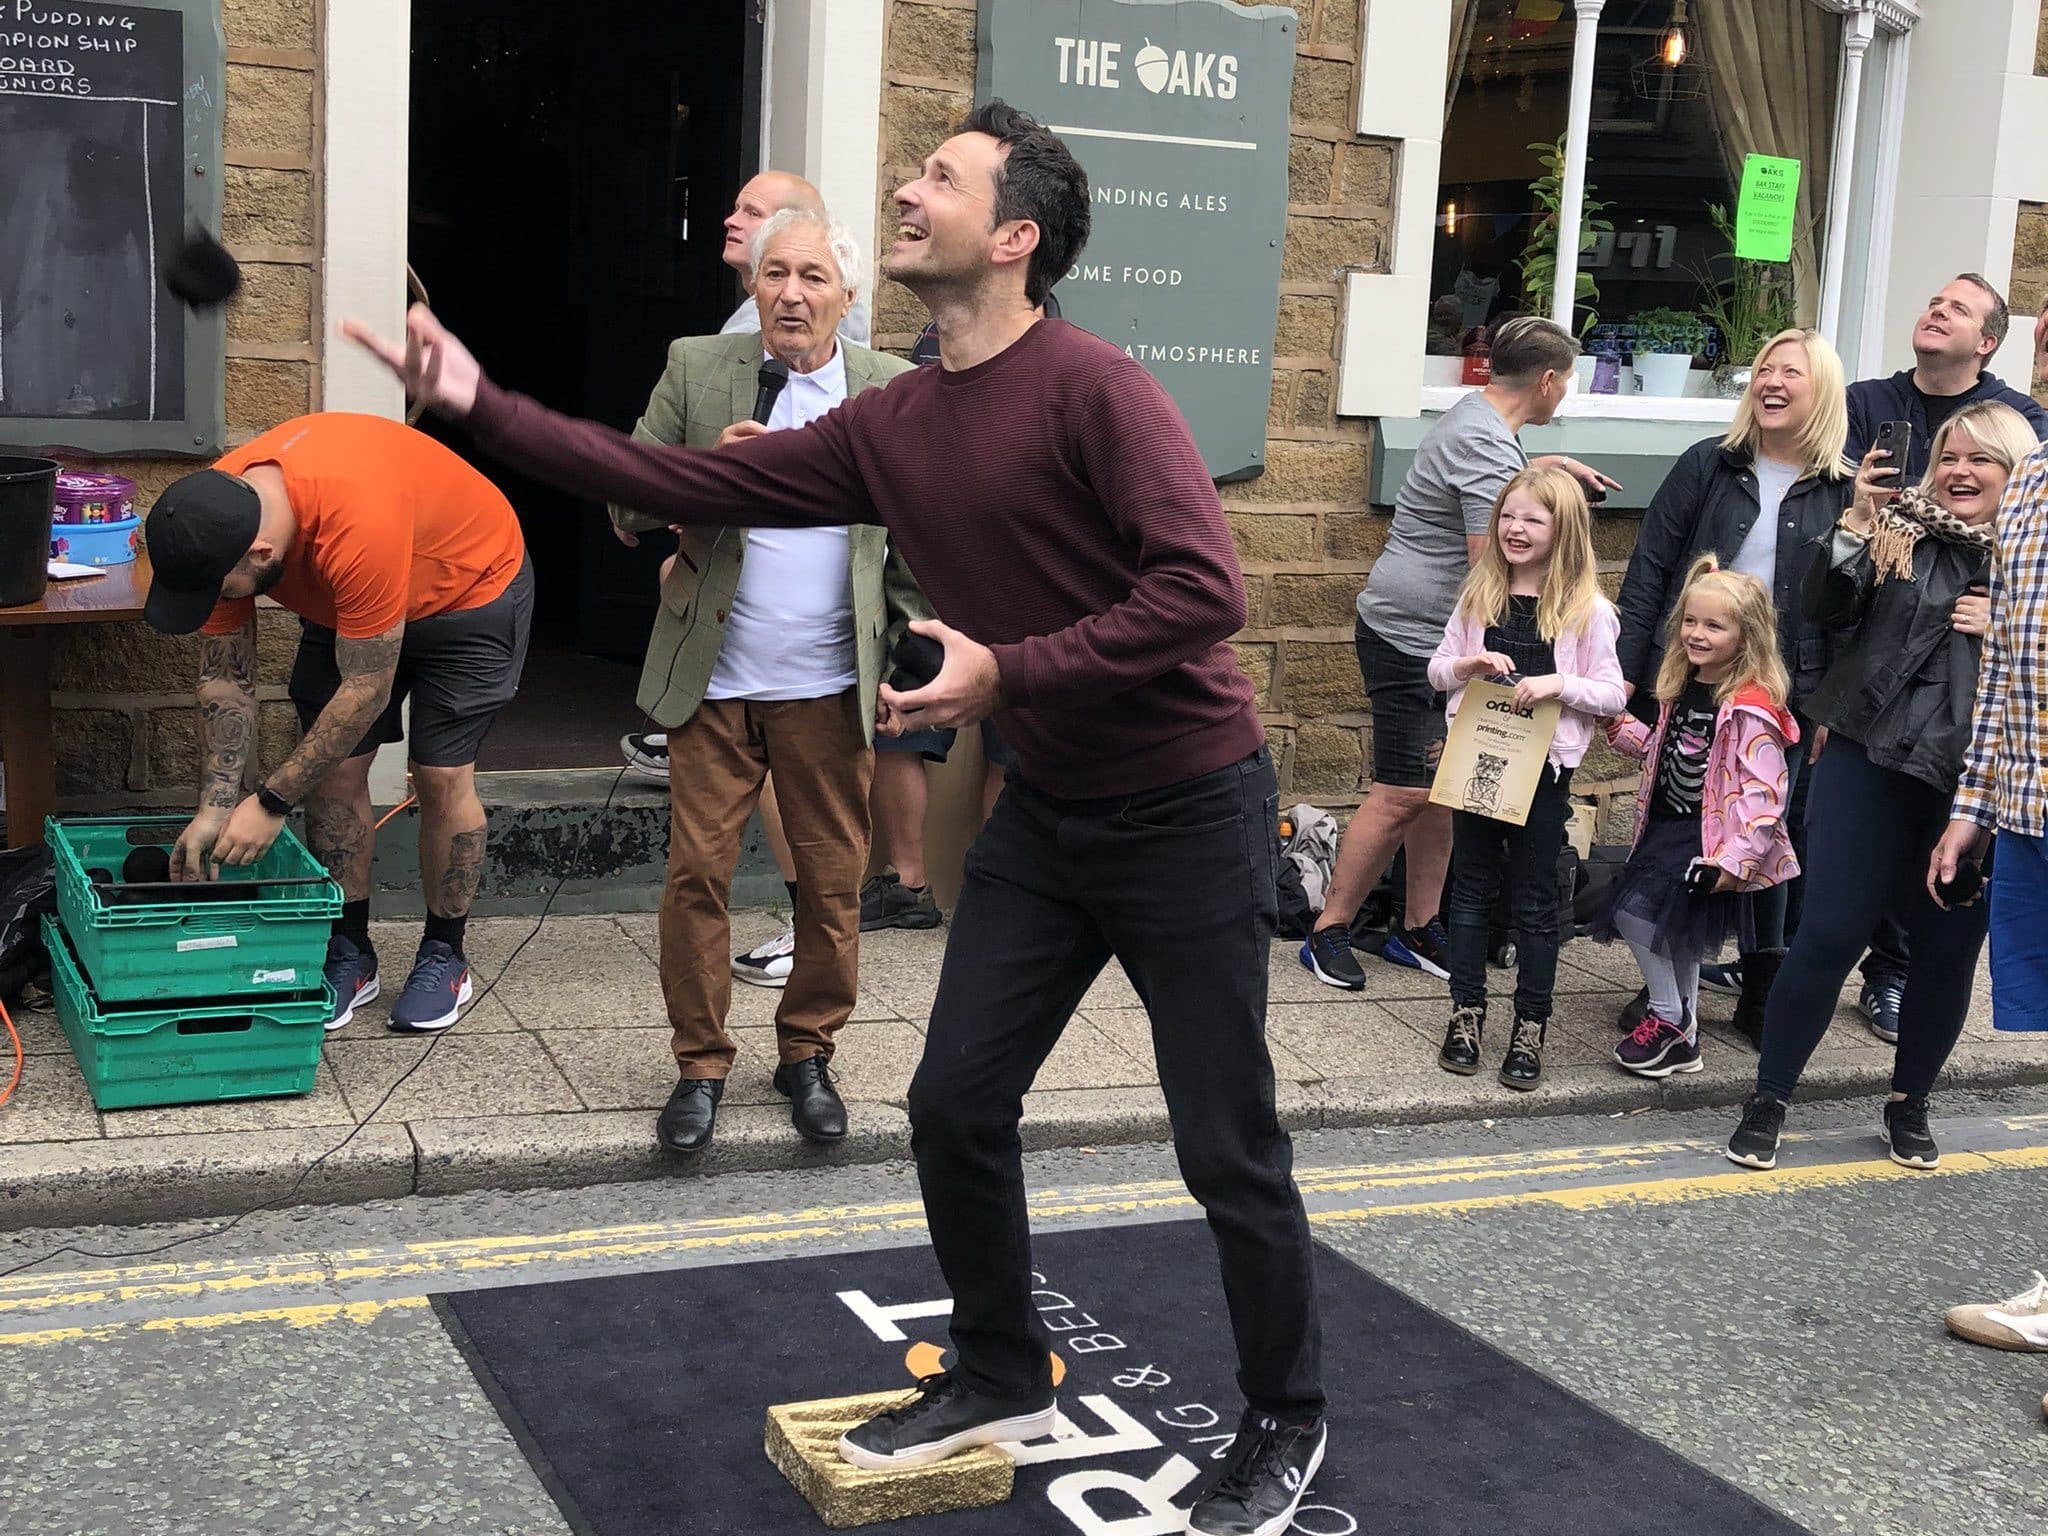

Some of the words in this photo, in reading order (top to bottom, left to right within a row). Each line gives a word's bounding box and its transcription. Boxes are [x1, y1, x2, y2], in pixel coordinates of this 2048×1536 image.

[1054, 37, 1121, 89] THE
[1179, 194, 1228, 212] ALES
[1123, 267, 1182, 285] FOOD
[1124, 344, 1260, 364] ATMOSPHERE
[1476, 724, 1526, 742] printing.com
[1032, 1271, 1127, 1353] BED
[1112, 1365, 1171, 1388] &
